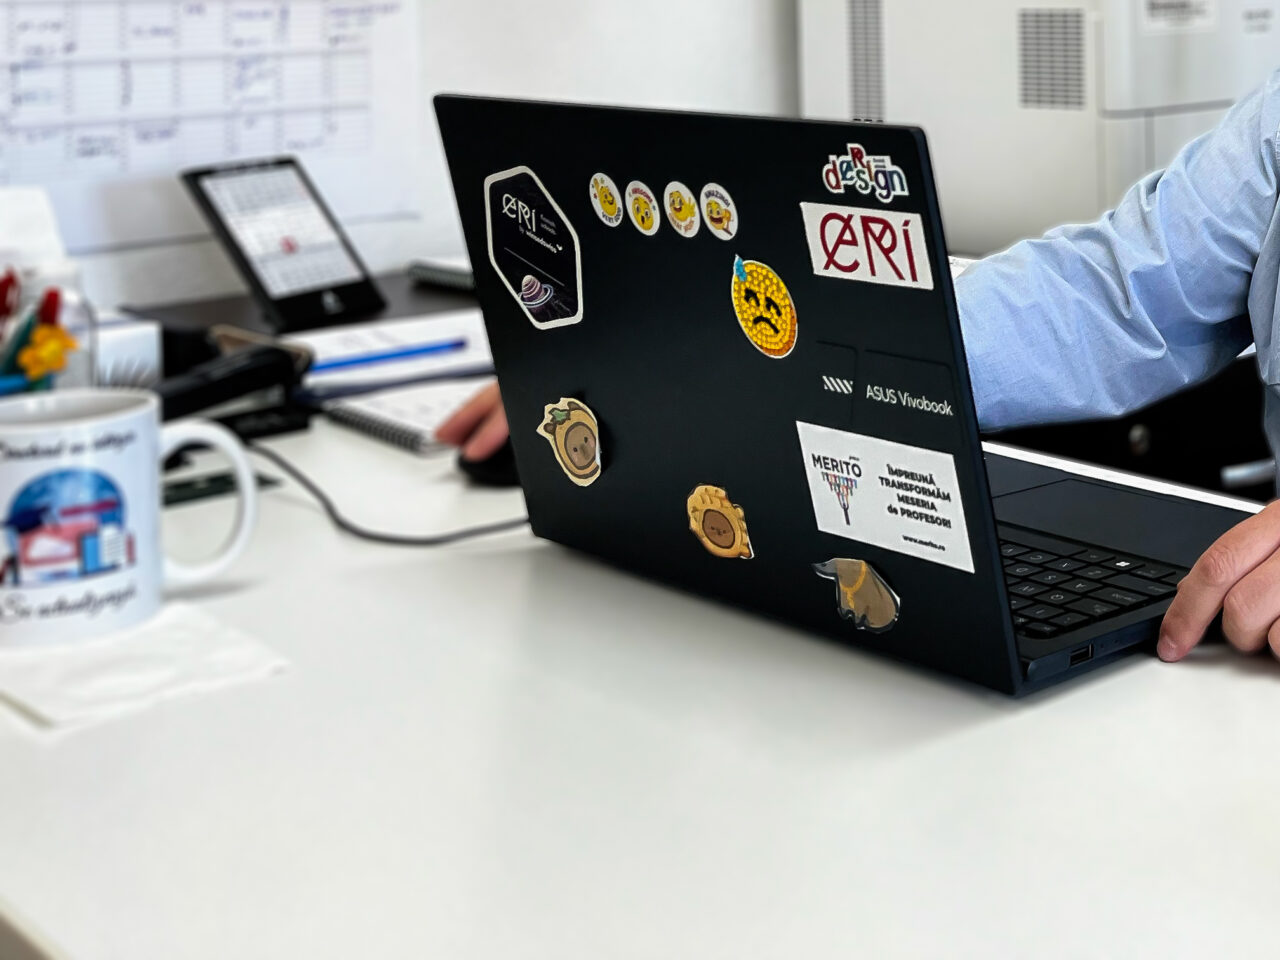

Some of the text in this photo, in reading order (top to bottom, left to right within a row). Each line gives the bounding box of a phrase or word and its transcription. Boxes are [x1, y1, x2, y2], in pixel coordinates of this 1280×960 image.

[866, 384, 953, 416] ASUS Vivobook
[811, 453, 862, 478] MERITO
[886, 463, 936, 487] ÎMPREUNĂ
[878, 476, 951, 503] TRANSFORMĂM
[887, 504, 899, 516] de
[896, 493, 938, 512] MESERIA
